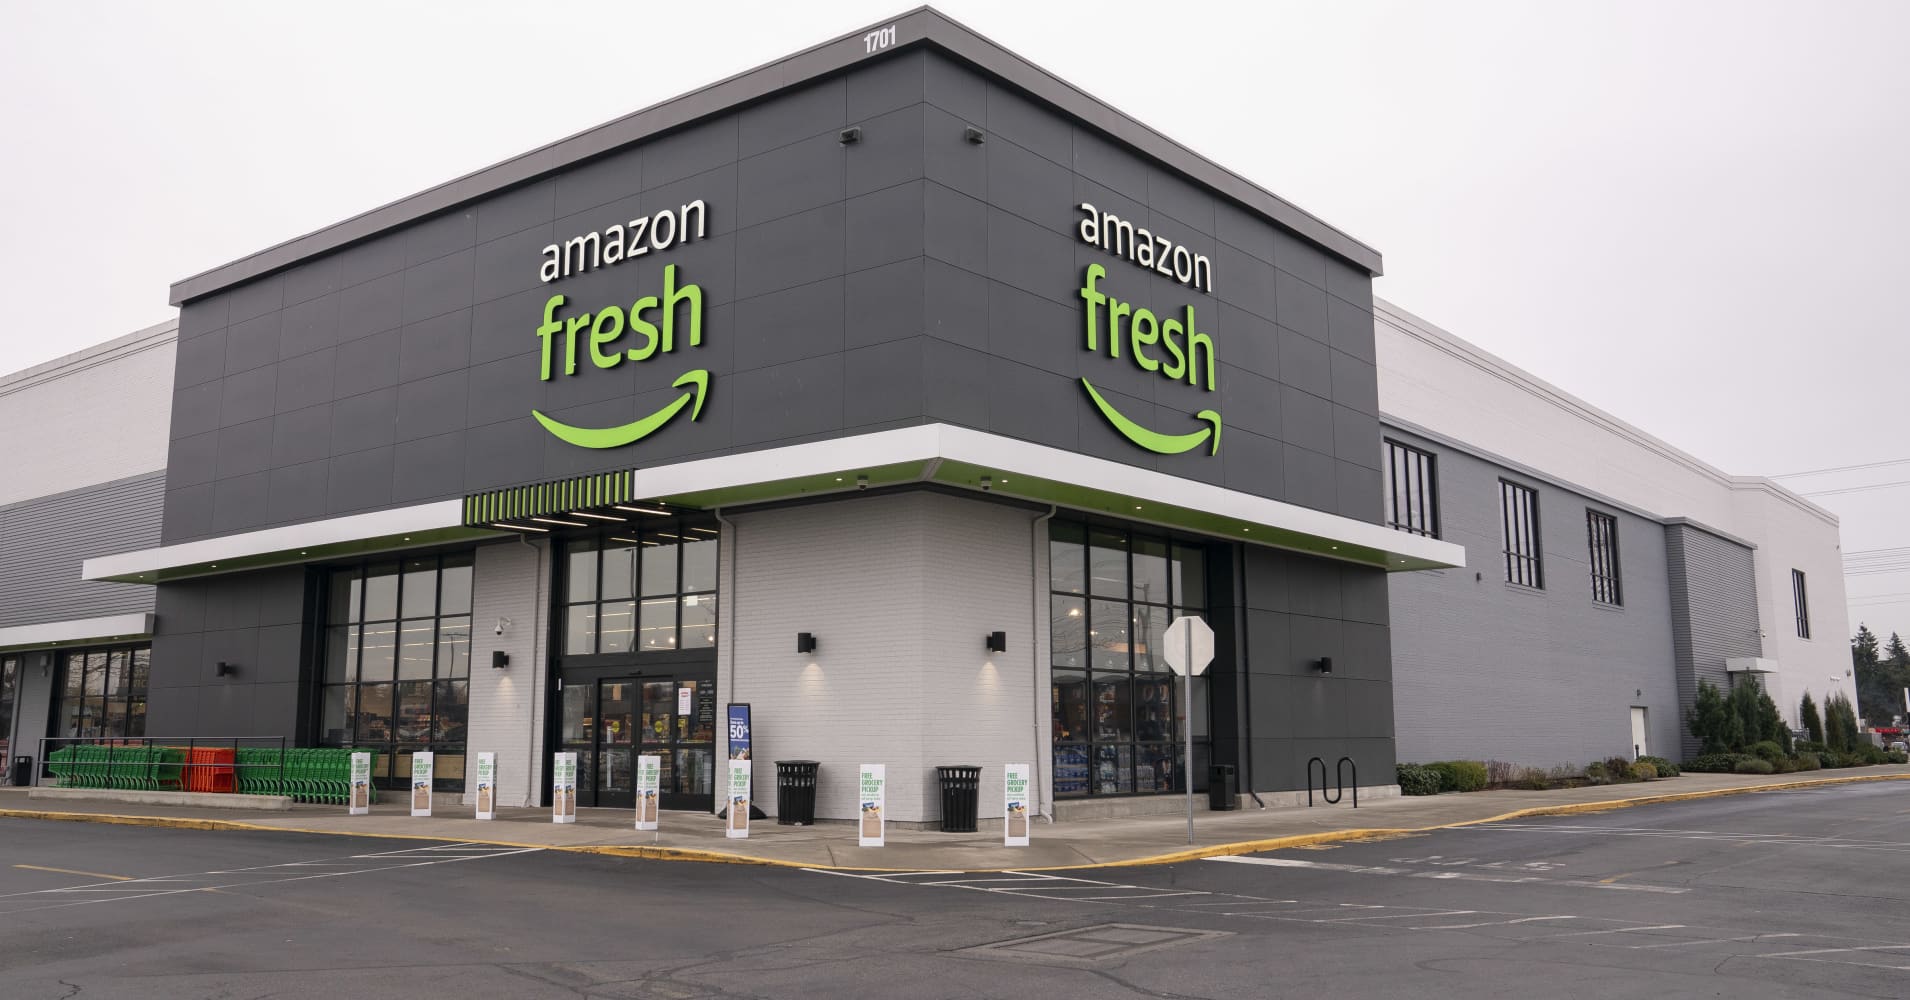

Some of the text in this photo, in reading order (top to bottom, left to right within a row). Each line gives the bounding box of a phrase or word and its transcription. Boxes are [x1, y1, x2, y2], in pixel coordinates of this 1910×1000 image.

[864, 24, 896, 54] 1701
[540, 199, 705, 283] amazon
[1080, 202, 1212, 293] amazon
[537, 263, 702, 381] fresh
[1080, 263, 1215, 392] fresh
[730, 724, 749, 739] 50%
